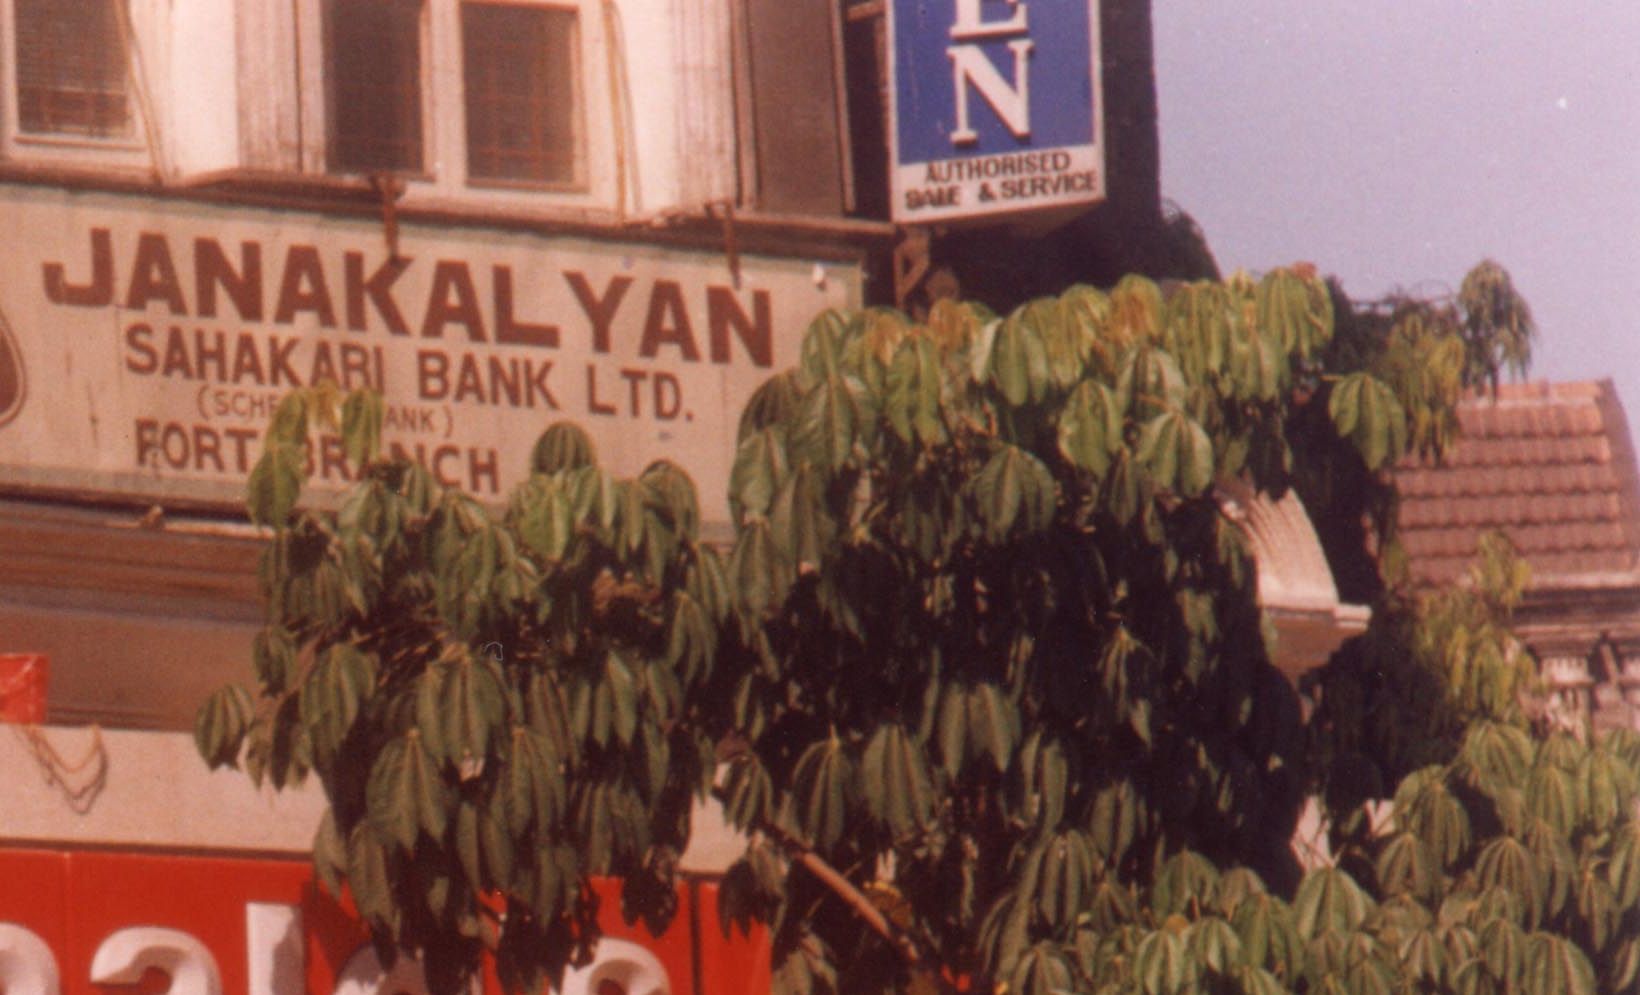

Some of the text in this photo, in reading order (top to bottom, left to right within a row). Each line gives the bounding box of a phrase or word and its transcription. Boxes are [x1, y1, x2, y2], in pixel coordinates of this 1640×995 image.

[924, 151, 1071, 183] AUTHORISED
[978, 182, 997, 201] &
[1000, 171, 1097, 200] SERVICE
[42, 227, 773, 367] JANAKALYAN
[125, 322, 695, 422] SAHAKARI BANK LTD.
[135, 419, 259, 473] FORT
